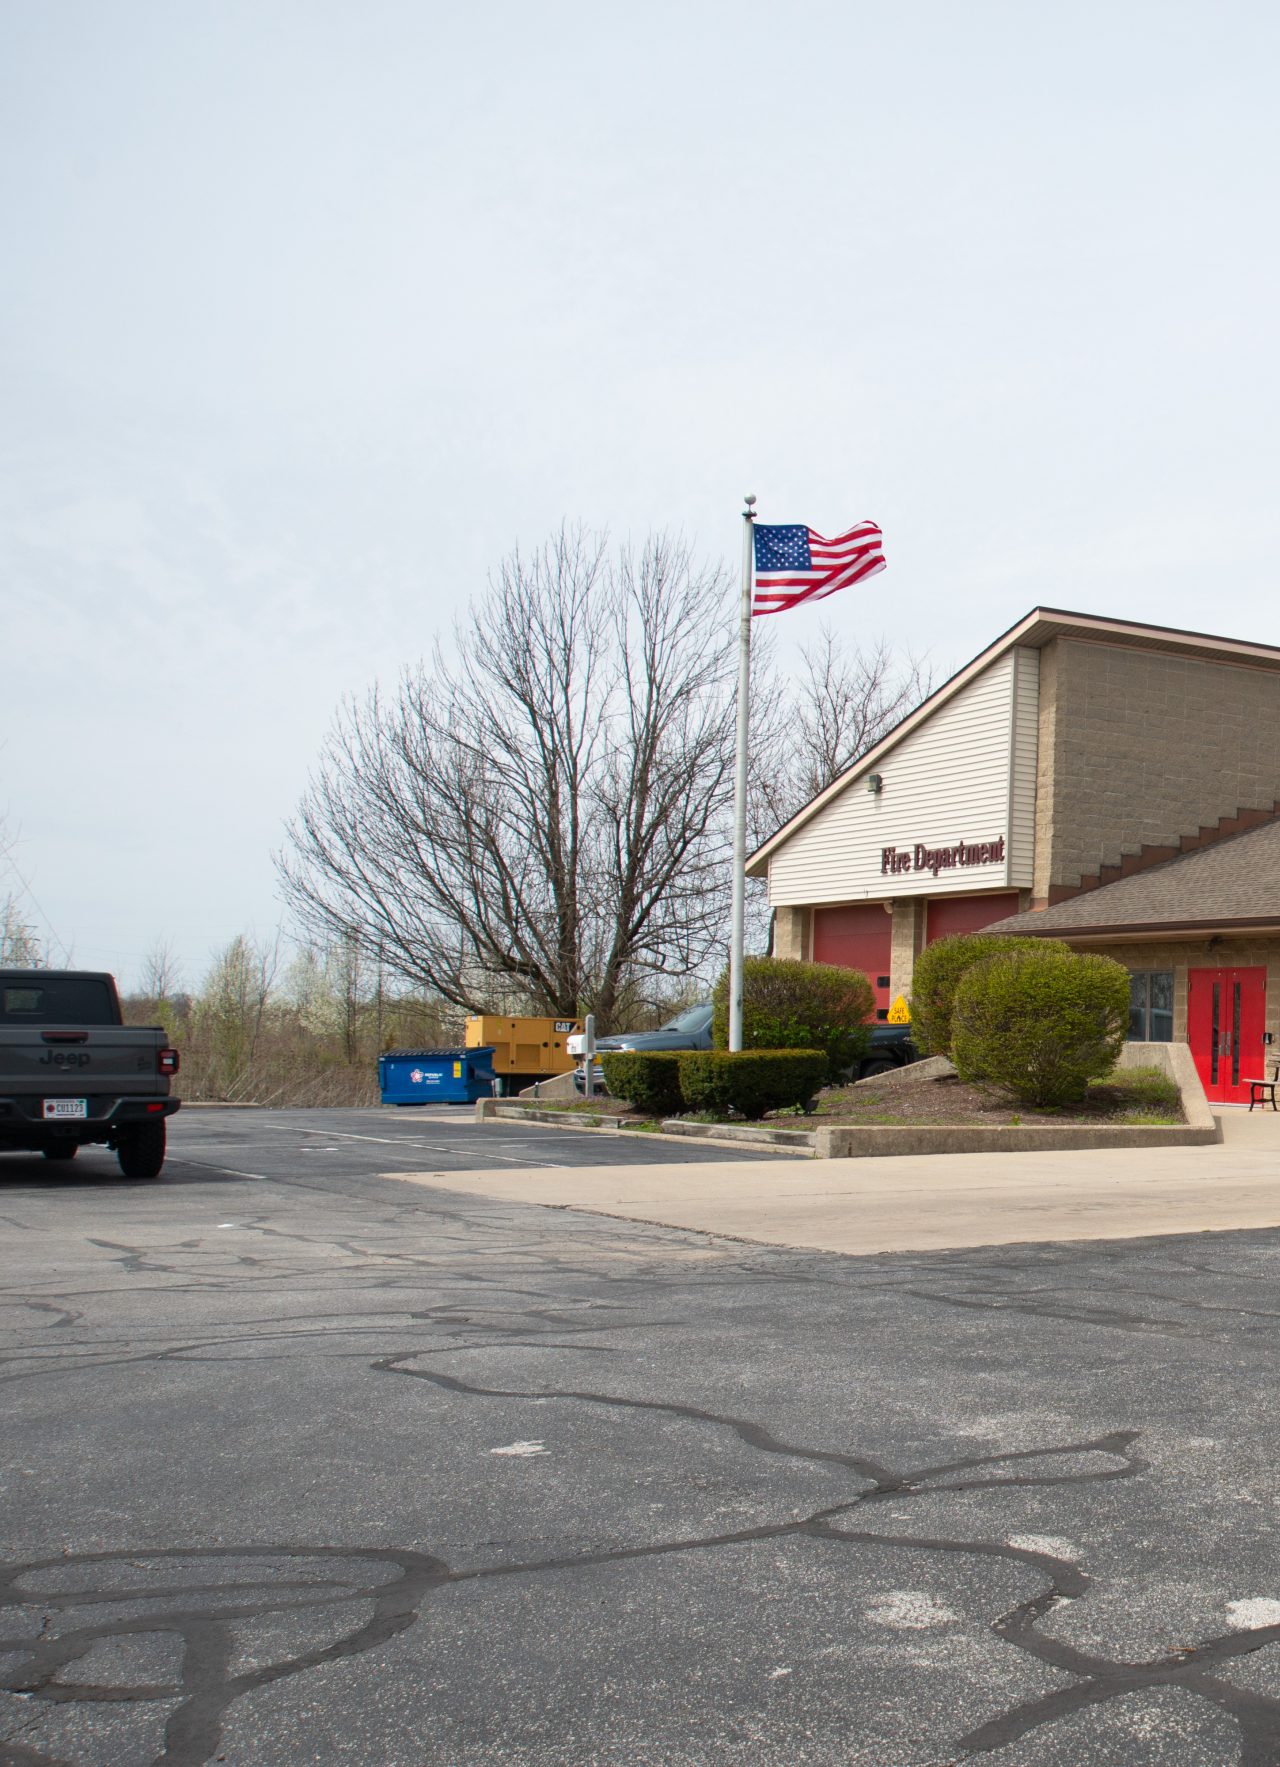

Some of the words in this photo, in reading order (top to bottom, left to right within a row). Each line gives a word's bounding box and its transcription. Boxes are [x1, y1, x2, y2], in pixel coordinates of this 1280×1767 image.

[880, 846, 911, 874] Fire
[913, 835, 1005, 876] Department
[893, 1007, 905, 1015] SAFE
[555, 1022, 571, 1032] CAT
[39, 1049, 90, 1068] Jeep
